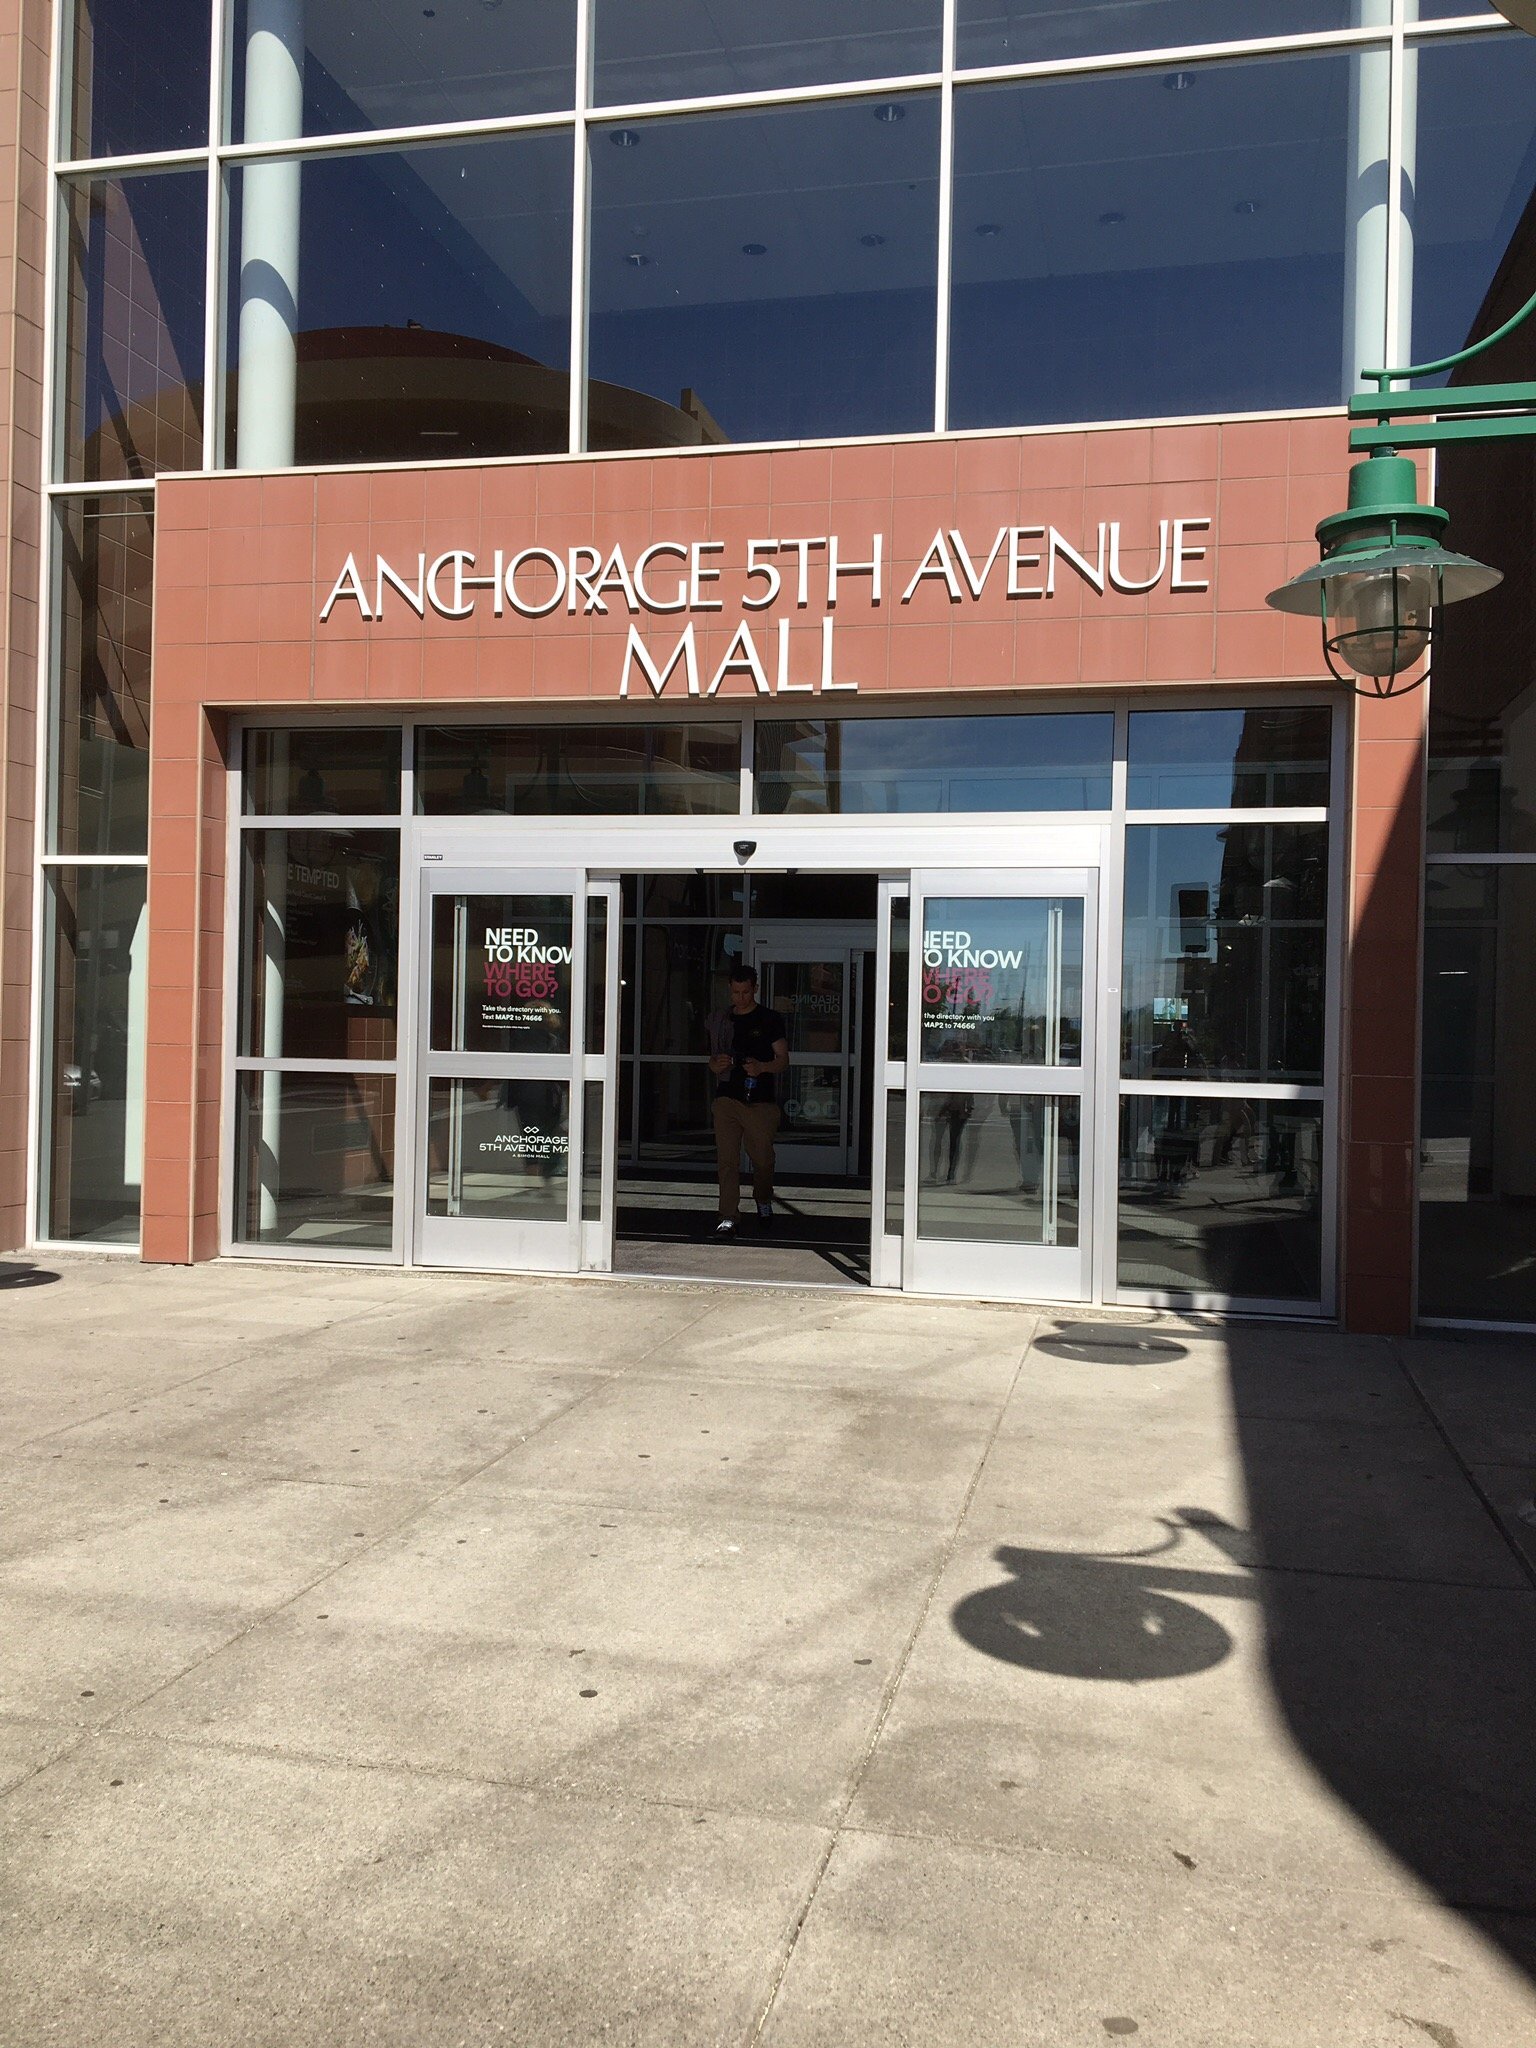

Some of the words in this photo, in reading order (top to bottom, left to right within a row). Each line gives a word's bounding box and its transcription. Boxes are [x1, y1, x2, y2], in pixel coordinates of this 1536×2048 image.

[319, 541, 725, 621] ANCHORAGE
[741, 533, 883, 609] 5TH
[901, 518, 1211, 604] AVENUE
[620, 616, 858, 697] MALL
[294, 864, 340, 888] TEMPTED
[485, 928, 539, 946] NEED
[484, 945, 513, 963] TO
[948, 949, 1023, 969] KNOW
[483, 962, 556, 980] WHERE
[483, 979, 512, 997] TO
[516, 979, 559, 998] GO?
[507, 1005, 534, 1014] directory
[936, 1012, 966, 1021] directory
[479, 1143, 502, 1151] 5TH
[504, 1144, 550, 1153] AVENUE
[494, 1135, 568, 1145] ANCHORAGE
